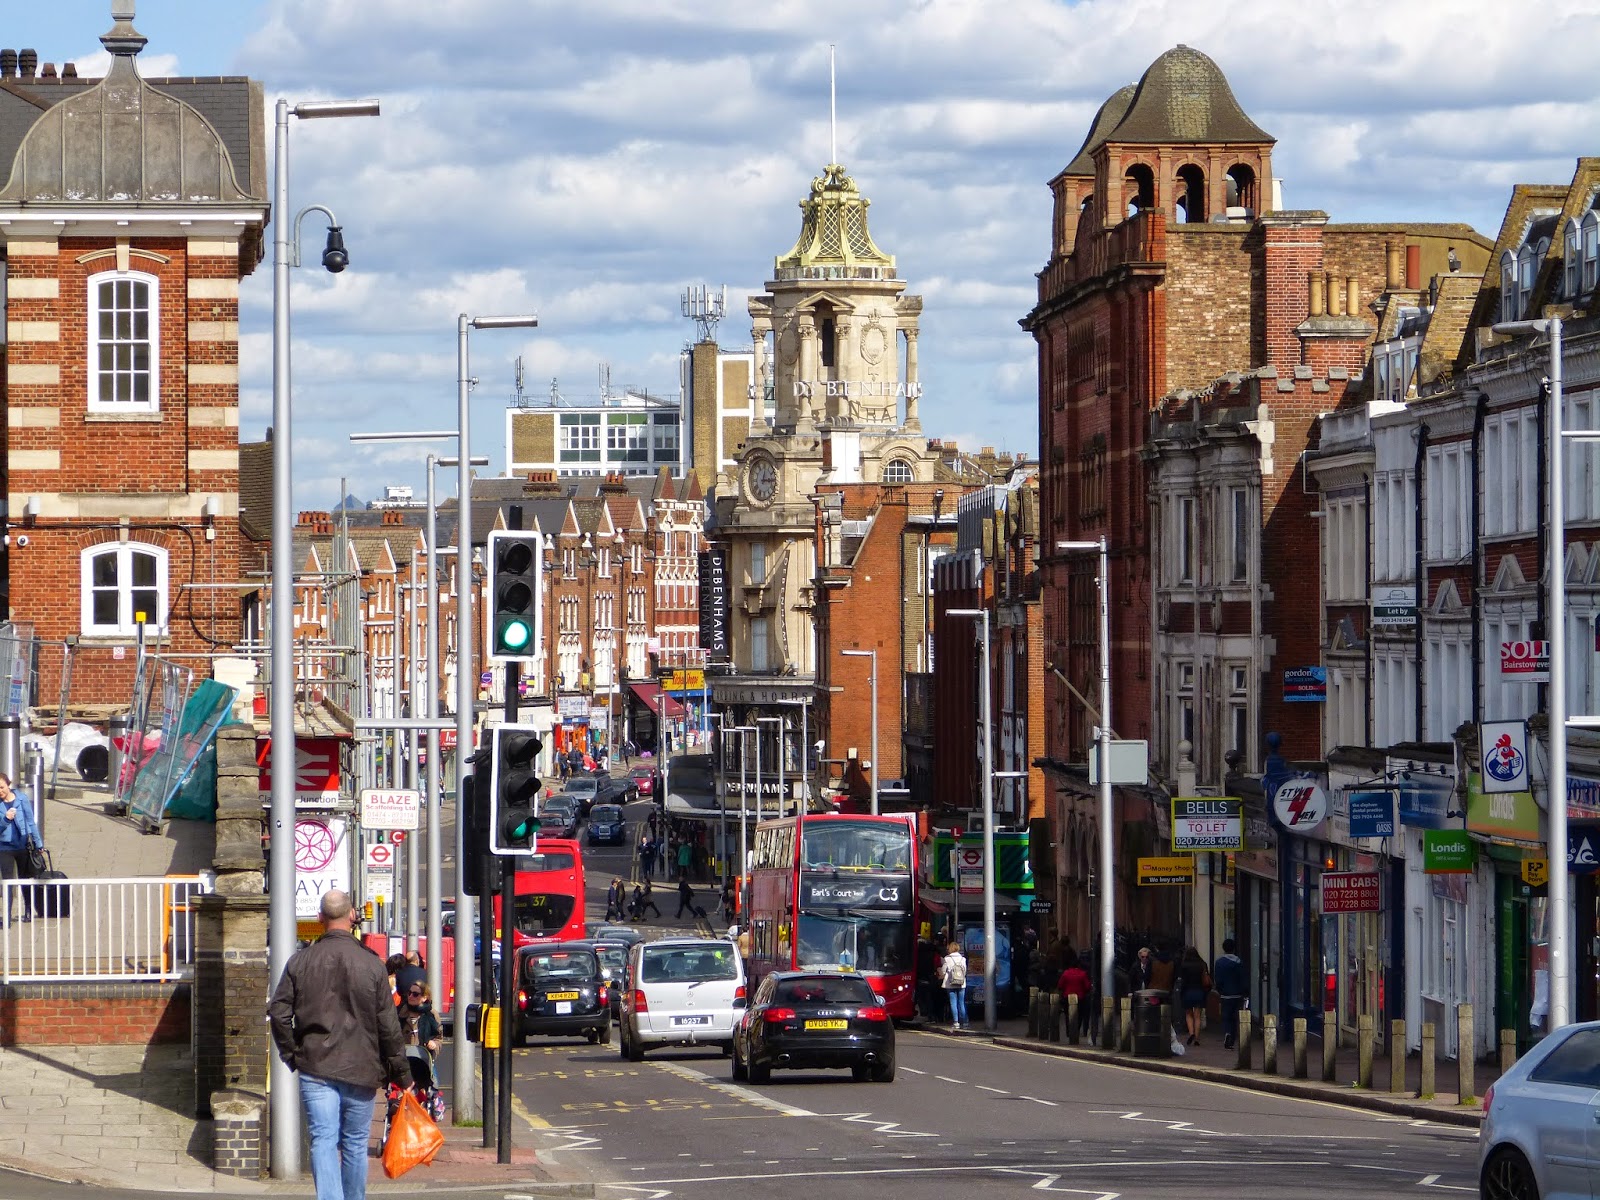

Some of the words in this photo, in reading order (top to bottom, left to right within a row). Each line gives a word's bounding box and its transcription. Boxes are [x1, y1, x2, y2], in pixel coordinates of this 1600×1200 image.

[701, 559, 710, 642] DEBENHAMS
[712, 557, 724, 650] DEBENHAMS
[1284, 669, 1312, 678] gordon
[299, 795, 337, 803] Junction
[371, 795, 411, 804] BLAZE
[1186, 801, 1228, 814] BELLS
[1188, 824, 1203, 832] TO
[1206, 824, 1227, 832] LET
[1376, 823, 1392, 833] OASIS
[1430, 842, 1466, 853] Londis
[1324, 878, 1348, 888] MINI
[1351, 877, 1378, 888] CABS
[811, 888, 830, 897] Earl's
[832, 888, 851, 897] Court
[879, 887, 899, 901] C3
[1324, 890, 1338, 899] 020
[1340, 890, 1359, 898] 7228
[532, 895, 546, 907] 37
[1324, 900, 1338, 909] 020
[1340, 900, 1359, 908] 7228
